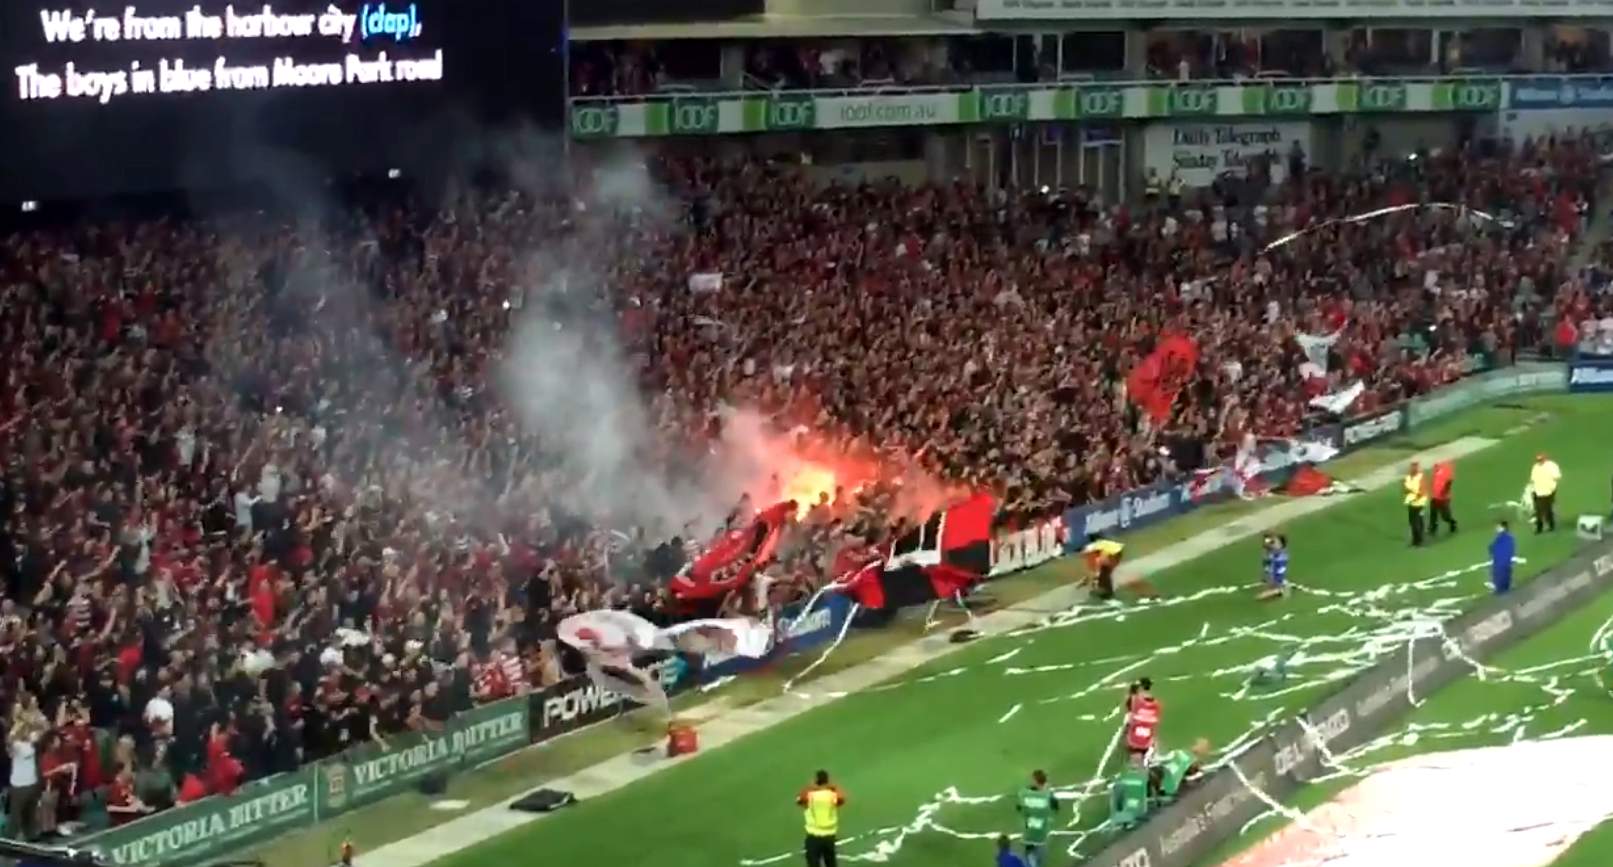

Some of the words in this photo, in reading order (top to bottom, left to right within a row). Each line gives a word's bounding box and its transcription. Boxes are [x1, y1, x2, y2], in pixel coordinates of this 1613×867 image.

[40, 9, 120, 42] We're
[124, 6, 181, 39] from
[185, 5, 223, 39] the
[226, 4, 315, 37] harbour
[318, 4, 357, 43] city
[15, 62, 62, 99] The
[66, 61, 128, 104] boys
[131, 60, 155, 93] in
[160, 58, 211, 92] blue
[215, 56, 269, 89] from
[273, 57, 343, 87] Moore
[346, 51, 394, 83] Park
[396, 49, 443, 80] road
[1215, 126, 1281, 146] Telegraph
[353, 737, 449, 785] VICTORIA
[112, 813, 225, 865] VICTORIA
[229, 784, 308, 828] BITTER
